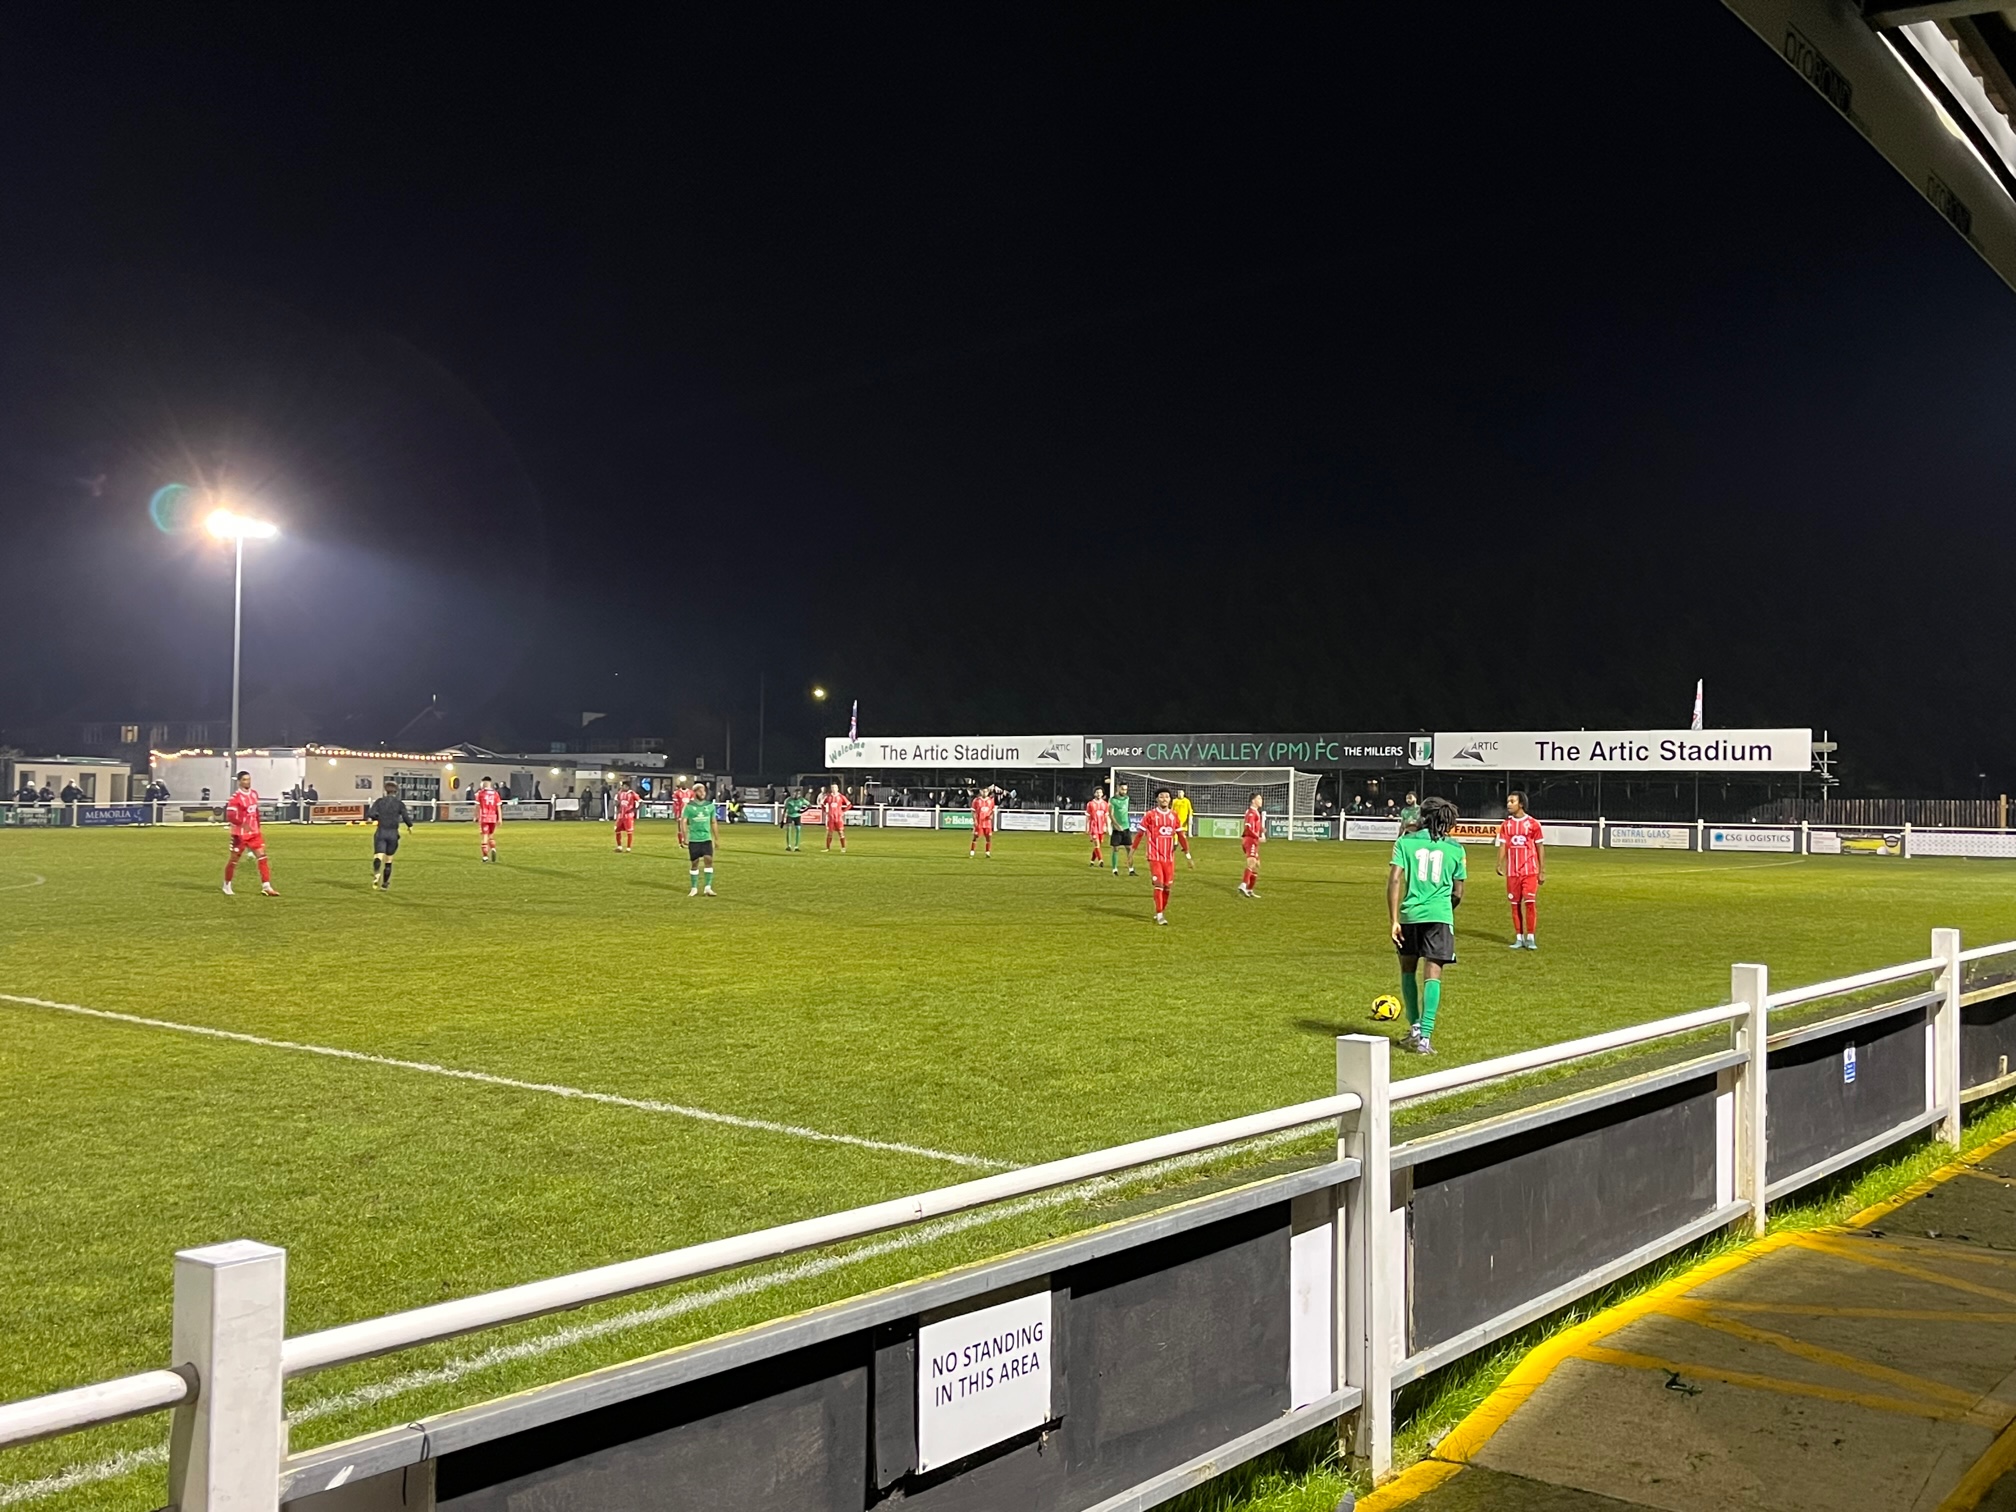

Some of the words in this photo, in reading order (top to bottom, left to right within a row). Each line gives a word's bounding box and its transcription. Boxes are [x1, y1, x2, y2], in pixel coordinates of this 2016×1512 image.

[829, 742, 865, 764] Welcome
[880, 745, 907, 760] The
[912, 744, 949, 760] Artic
[954, 744, 1019, 761] Stadium
[1050, 744, 1071, 752] ARTIC
[1106, 747, 1130, 756] HOME
[1131, 747, 1143, 756] OF
[1146, 743, 1193, 760] CRAY
[1197, 743, 1263, 760] VALLEY
[1269, 742, 1311, 761] (PM)
[1315, 743, 1339, 760] FC
[1343, 746, 1362, 756] THE
[1364, 746, 1404, 756] MILLERS
[1470, 741, 1499, 751] ARTIC
[1534, 741, 1580, 761] The
[1589, 740, 1649, 761] Artic
[1659, 739, 1773, 761] Stadium
[84, 810, 131, 819] MEMORIA
[327, 805, 361, 814] FARRAR
[1454, 825, 1497, 835] FARRAR
[1612, 828, 1645, 838] CENTRAL
[1646, 829, 1671, 839] GLASS
[1725, 833, 1742, 842] CSG
[1745, 833, 1791, 843] LOGISTICS
[1414, 848, 1444, 883] 11
[932, 1352, 958, 1379] NO
[963, 1322, 1043, 1367] STANDING
[935, 1382, 953, 1407] IN
[958, 1367, 994, 1398] THIS
[999, 1352, 1040, 1384] AREA
